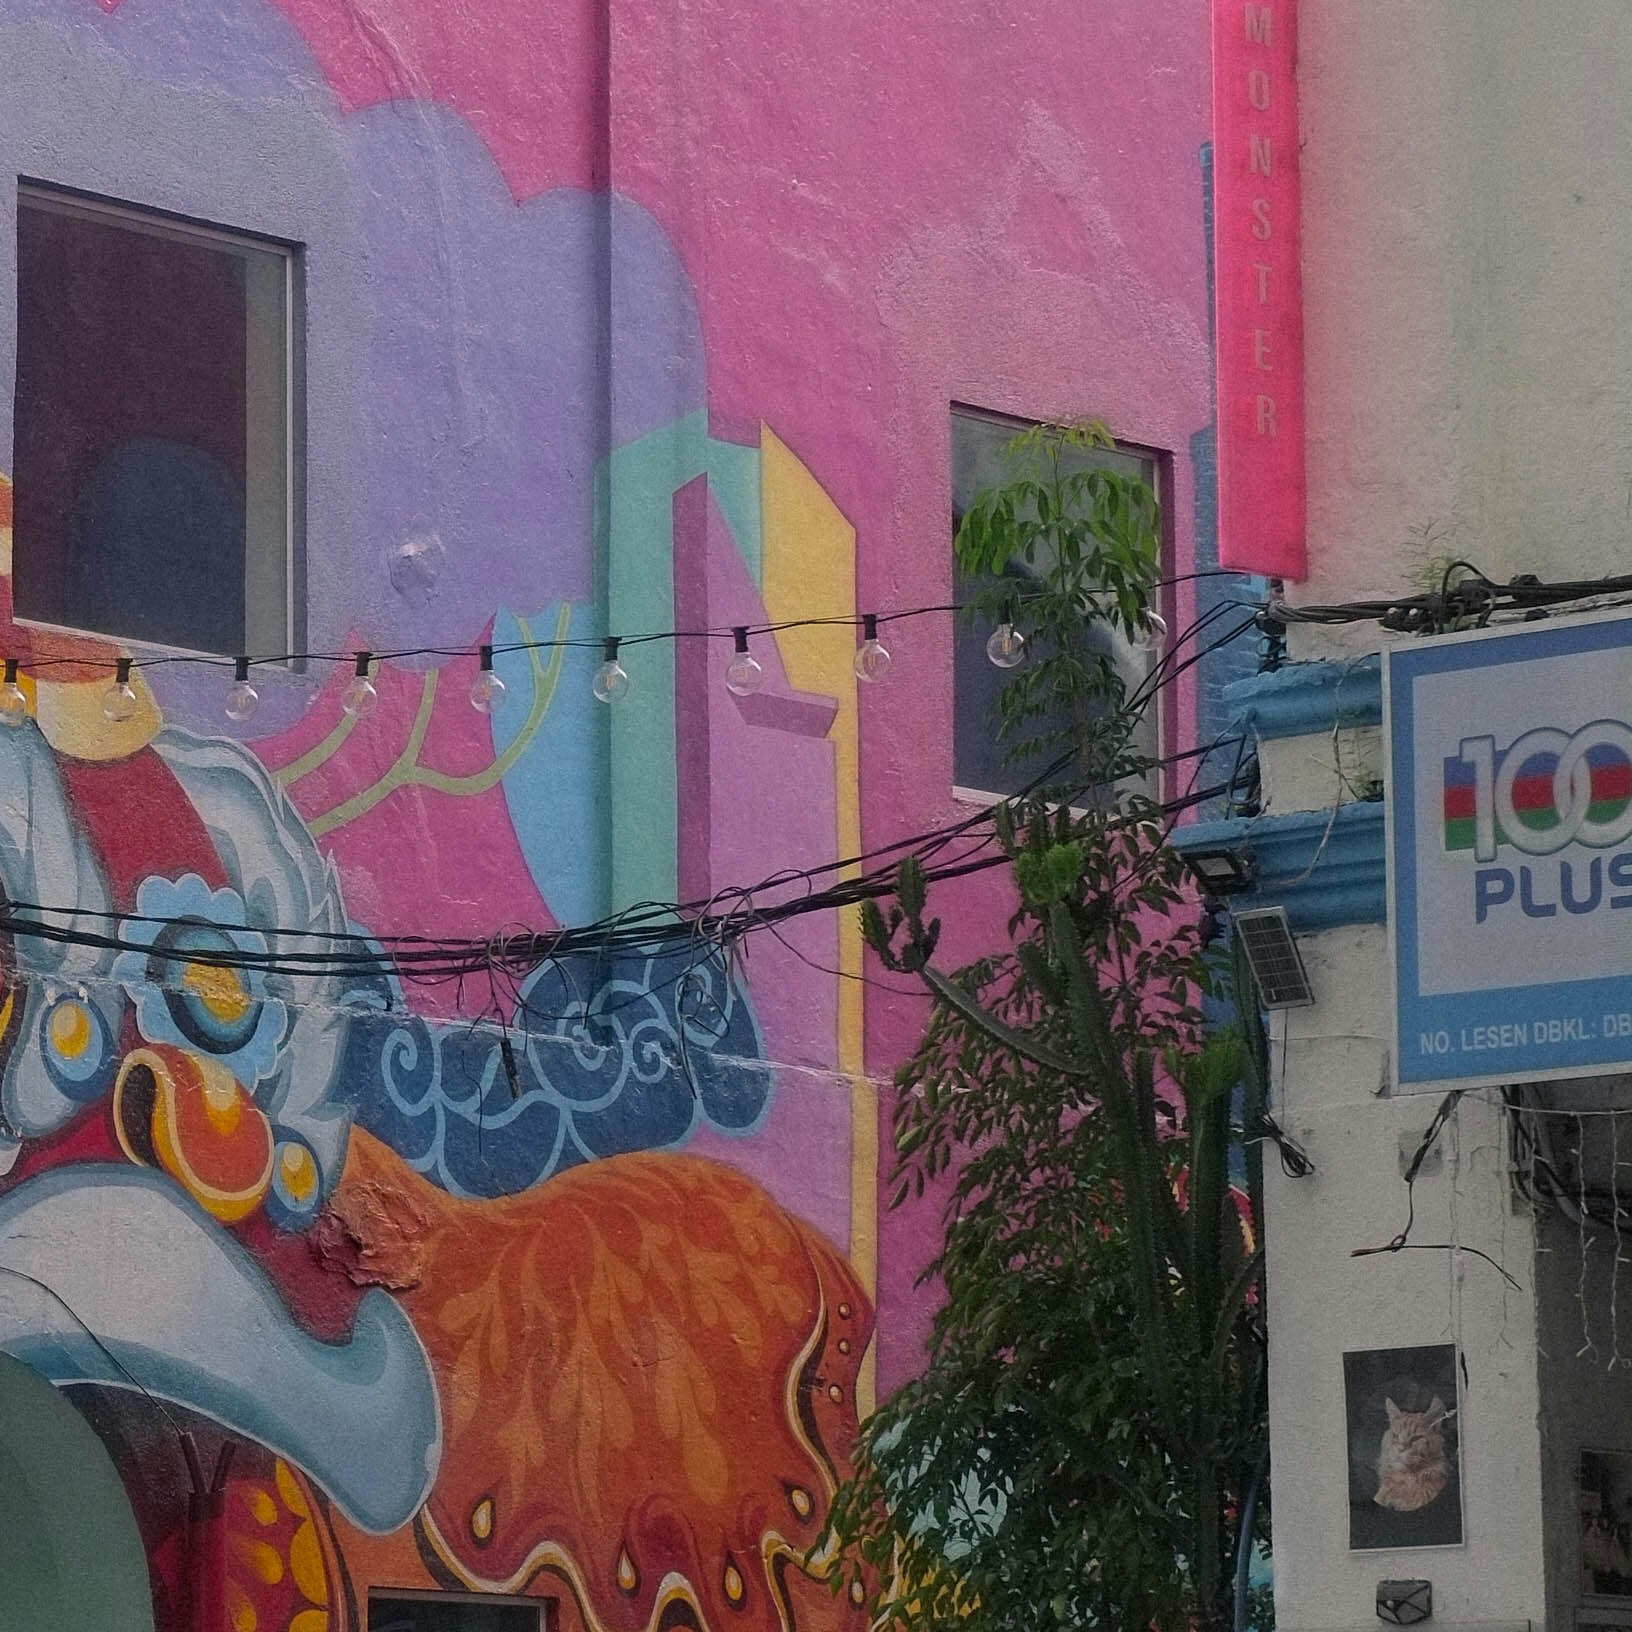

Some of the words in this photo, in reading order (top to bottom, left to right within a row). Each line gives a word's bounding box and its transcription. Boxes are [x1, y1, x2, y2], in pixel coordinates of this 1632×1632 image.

[1243, 1, 1278, 437] MONSTER
[1458, 718, 1632, 864] 100
[1474, 852, 1632, 925] PLUS
[1419, 1030, 1455, 1056] NO.
[1460, 1023, 1528, 1051] LESEN
[1533, 1016, 1596, 1045] DBKL:
